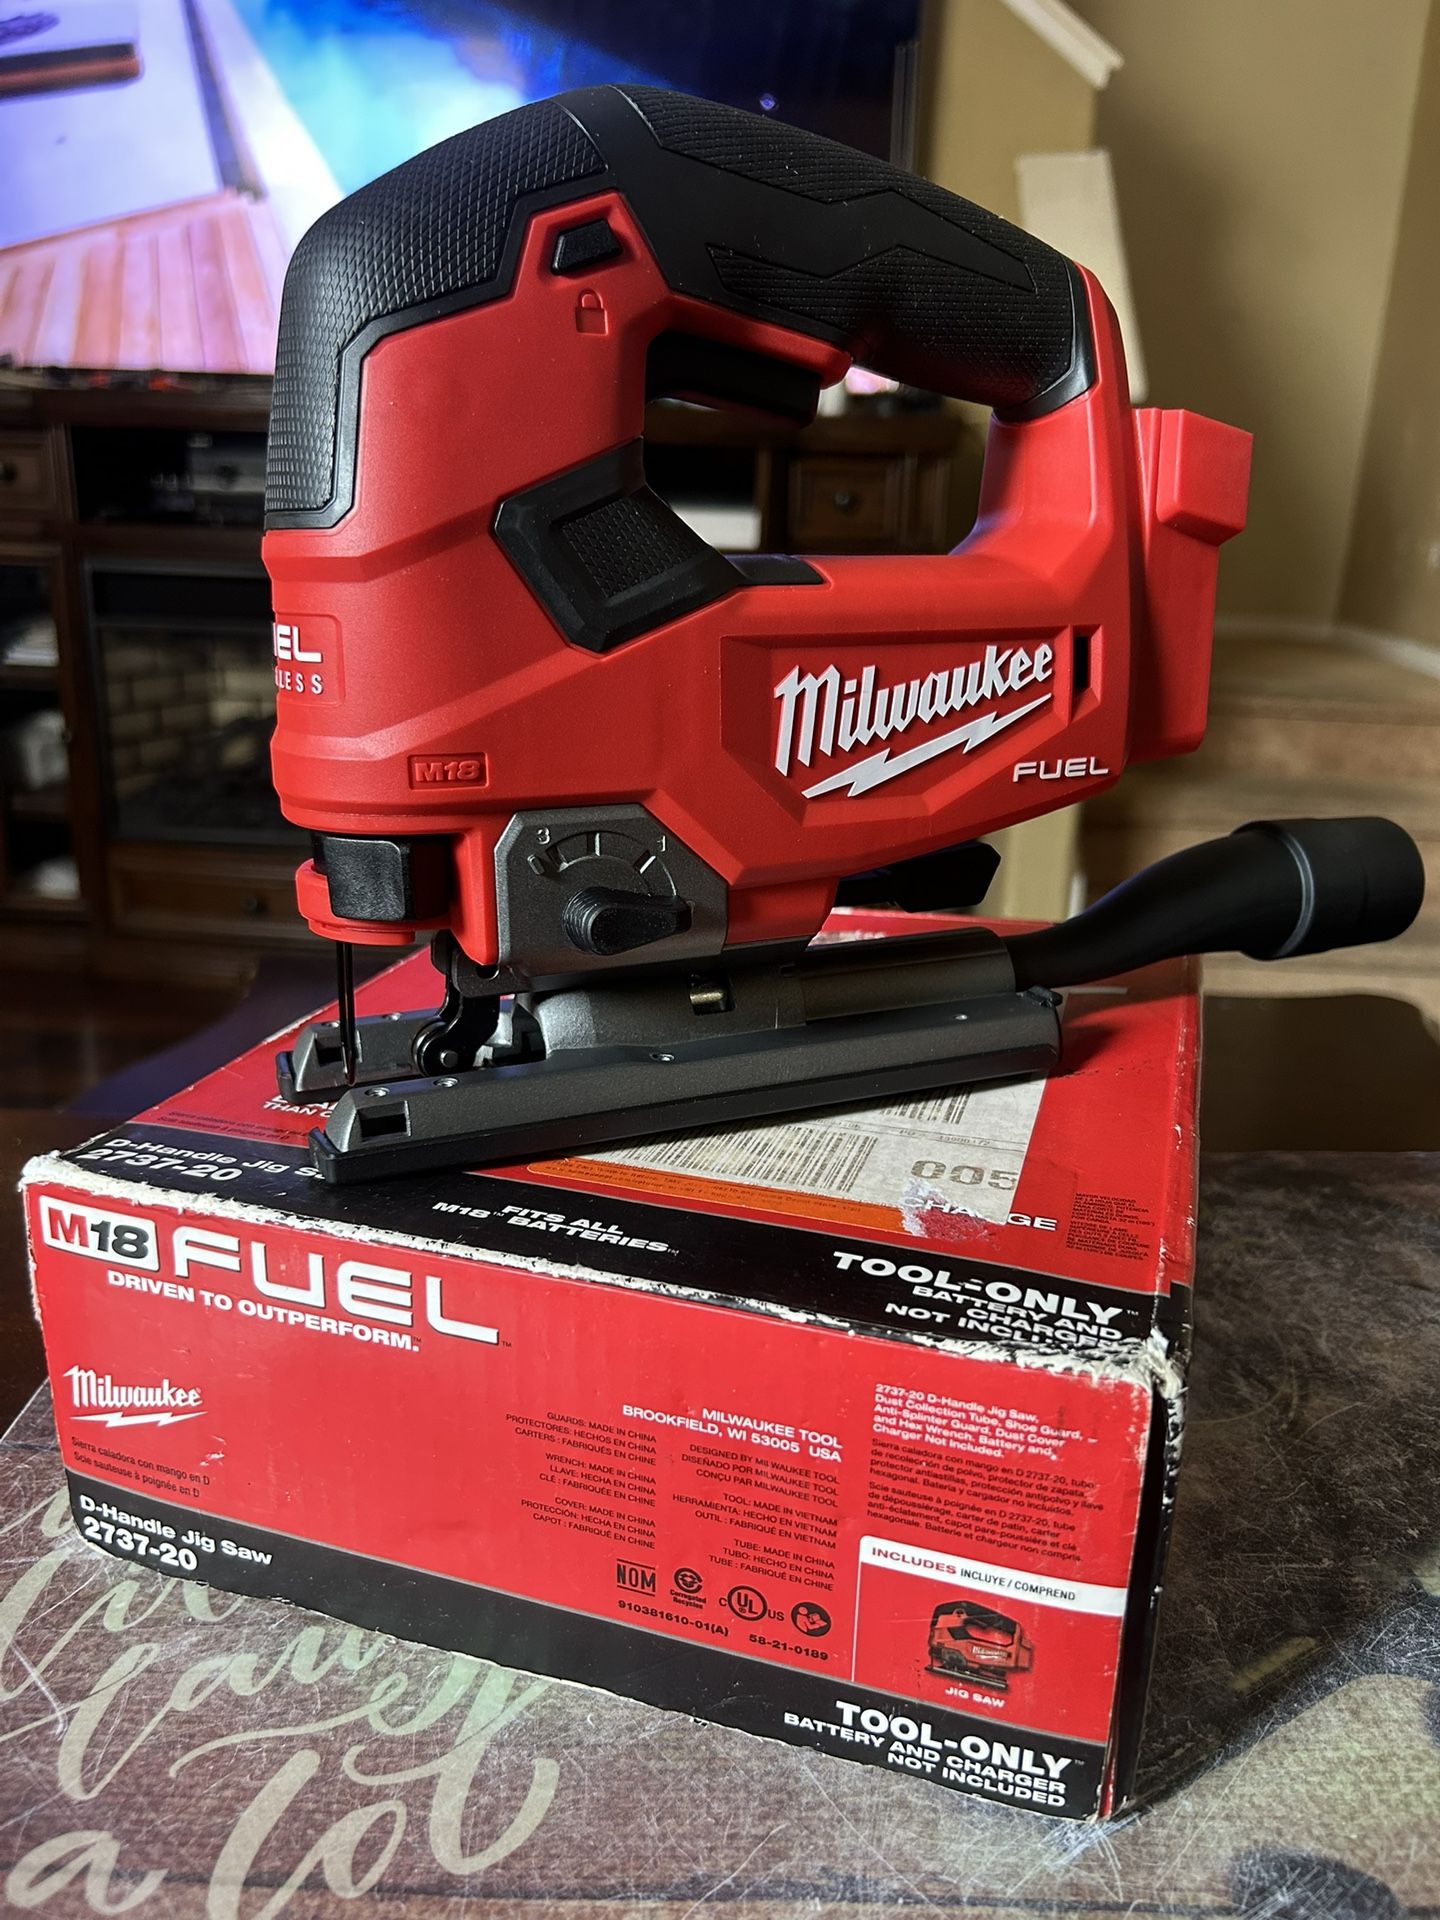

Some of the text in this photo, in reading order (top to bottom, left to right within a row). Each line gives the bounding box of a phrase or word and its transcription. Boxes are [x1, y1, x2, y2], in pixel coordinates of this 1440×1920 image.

[275, 668, 323, 694] LESS
[774, 643, 1052, 777] Milwaukee
[415, 761, 480, 782] M18
[1013, 757, 1108, 782] FUEL
[537, 828, 550, 844] 3
[263, 1101, 318, 1115] THAN
[75, 1149, 242, 1181] 2737-20
[104, 1138, 290, 1174] D-Handle Jig
[432, 1202, 669, 1252] M18 BATTERIES
[501, 1205, 625, 1235] FITS ALL
[49, 1207, 499, 1345] M18 FUEL
[833, 1251, 1122, 1325] TOOL-ONLY
[108, 1270, 420, 1352] DRIVEN TO OUTPERFORM.
[885, 1303, 951, 1323] NOT
[912, 1285, 1123, 1340] BATTERY AND
[63, 1365, 203, 1408] Milwaukee
[875, 1383, 1038, 1425] 2737-20 D-Handle Jig Saw,
[546, 1411, 656, 1443] GUARDS: MADE IN CHINA
[702, 1407, 842, 1449] MILWAUKEE TOOL
[874, 1393, 901, 1406] Dust
[905, 1399, 965, 1418] Collection
[1005, 1417, 1037, 1432] Shoe
[874, 1403, 947, 1426] Anti-Splinter
[995, 1426, 1024, 1440] Dust
[1027, 1432, 1065, 1448] Cover
[505, 1413, 656, 1454] PROTECTORES: HECHOS EN CHINA
[515, 1427, 655, 1466] CARTERS FABRIQUÉS EN CHINE
[622, 1404, 841, 1462] BROOKFIELD, WI 53005 USA
[872, 1423, 1004, 1458] Charger Not Included.
[873, 1415, 897, 1426] and
[899, 1418, 922, 1431] Hex
[978, 1434, 1024, 1453] Battery
[1027, 1445, 1053, 1456] and
[545, 1452, 656, 1484] WRENCH: MADE IN CHINA
[549, 1464, 655, 1495] LLAVE: HECHA EN CHINA
[681, 1453, 838, 1496] DISEÑADO POR MILWAUKEE TOOL
[689, 1443, 838, 1484] DESIGNED BY MILWAUKEE TOOL
[539, 1473, 655, 1507] CLÉ FABRIQUÉE EN CHINE
[696, 1468, 838, 1508] CONÇU PAR MILWAUKEE TOOL
[521, 1499, 655, 1538] PROTECCIÓN: HECHA EN CHINA
[554, 1496, 655, 1527] COVER: MADE IN CHINA
[672, 1493, 837, 1538] HERRAMIENTA: HECHO EN VIETNAM
[723, 1492, 837, 1526] TOOL: MADE IN VIETNAM
[79, 1494, 271, 1567] D-Handle Jig Saw
[83, 1516, 198, 1571] 2737-20
[533, 1512, 654, 1549] CAPOT FABRIQUÉ EN CHINE
[694, 1509, 836, 1549] OUTIL FABRIQUÉ EN VIETNAM
[709, 1554, 833, 1591] TUBE FABRIQUÉ EN CHINE
[723, 1546, 833, 1580] TUBO: HECHO EN CHINA
[734, 1538, 834, 1569] TUBE: MADE IN CHINA
[616, 1563, 656, 1593] NOM
[871, 1547, 1075, 1601] INCLUDES INCLUYE COMPREND
[618, 1600, 729, 1637] 910381610-01(A)
[737, 1592, 758, 1615] UL
[768, 1610, 785, 1621] US
[749, 1634, 829, 1661] 58-21-0189
[945, 1686, 1005, 1708] JIG SAW
[783, 1712, 1066, 1795] BATTERY AND CHARGER
[835, 1700, 1072, 1781] TOOL-ONLY
[887, 1752, 1065, 1807] NOT INCLUDED
